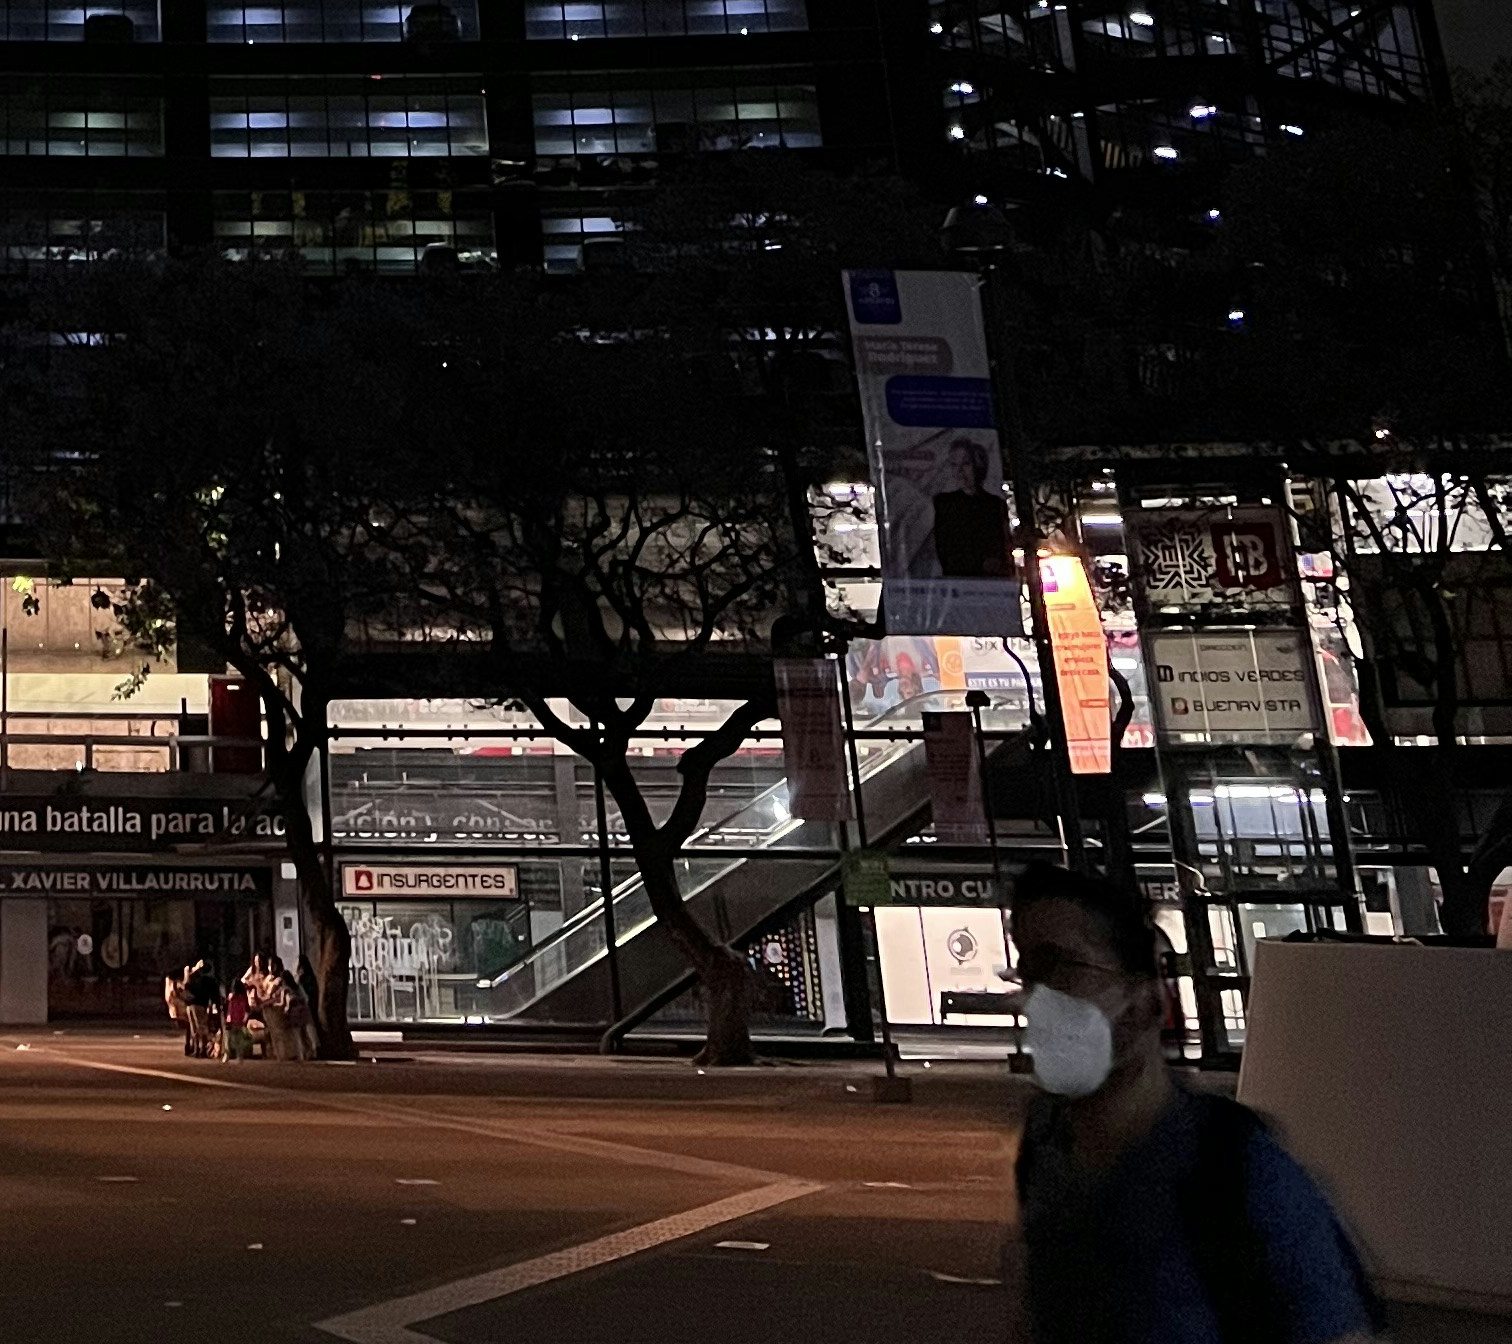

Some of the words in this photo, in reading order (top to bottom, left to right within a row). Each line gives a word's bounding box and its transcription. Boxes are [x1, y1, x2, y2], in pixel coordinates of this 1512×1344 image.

[1234, 669, 1305, 682] VERDES
[1193, 699, 1301, 713] BUENAVISTA
[45, 804, 142, 834] batalla
[149, 811, 215, 841] para
[11, 872, 90, 890] XAVIER
[96, 872, 257, 891] VILLAURRUTIA
[376, 873, 506, 890] INSURGENTES
[889, 880, 955, 898] NTRO
